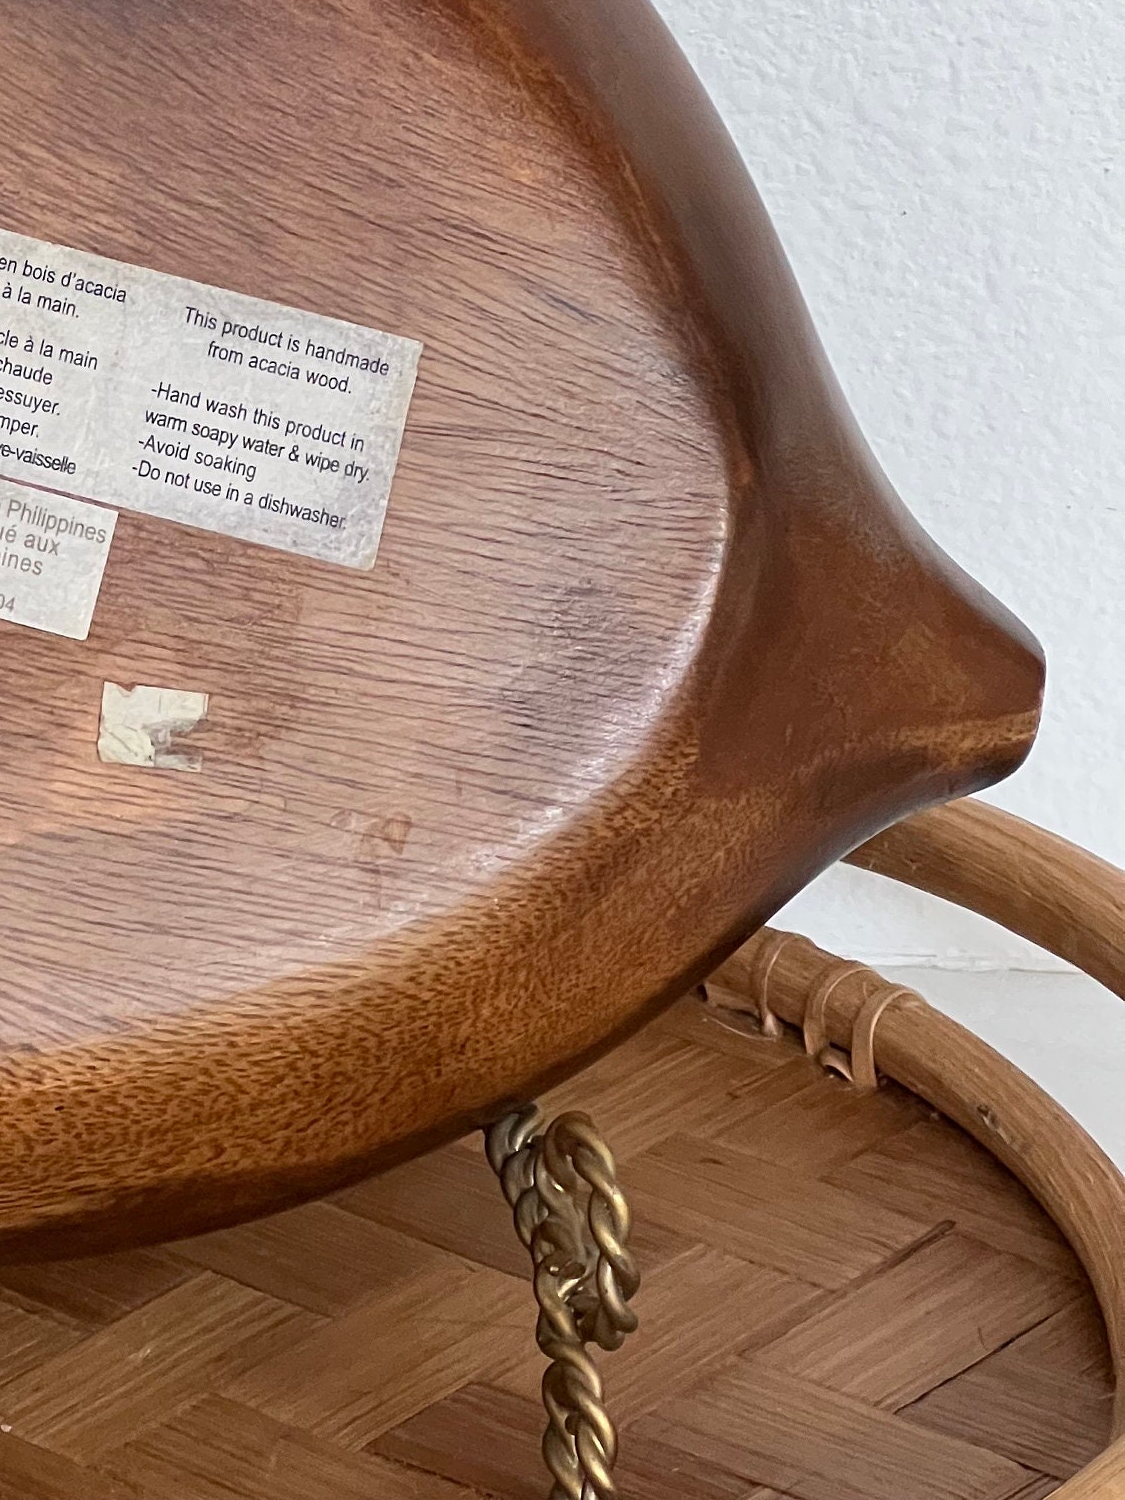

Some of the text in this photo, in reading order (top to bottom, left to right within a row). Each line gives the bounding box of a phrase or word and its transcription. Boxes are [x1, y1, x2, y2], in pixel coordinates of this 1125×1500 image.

[2, 283, 12, 299] à
[18, 286, 31, 305] la
[37, 295, 79, 319] main.
[23, 260, 55, 284] bois
[61, 271, 127, 303] d'acacia
[24, 335, 34, 352] à
[40, 338, 54, 358] la
[58, 348, 98, 370] main
[185, 306, 390, 376] This product is handmade
[208, 341, 352, 394] from acacia wood.
[151, 382, 364, 452] -Hand wash this product in
[139, 434, 257, 482] -Avoid soaking
[145, 409, 371, 484] warm soapy water & wipe dry.
[132, 460, 347, 531] -Do not use in a dishwasher.
[7, 499, 107, 544] Philippines
[23, 534, 60, 556] aux
